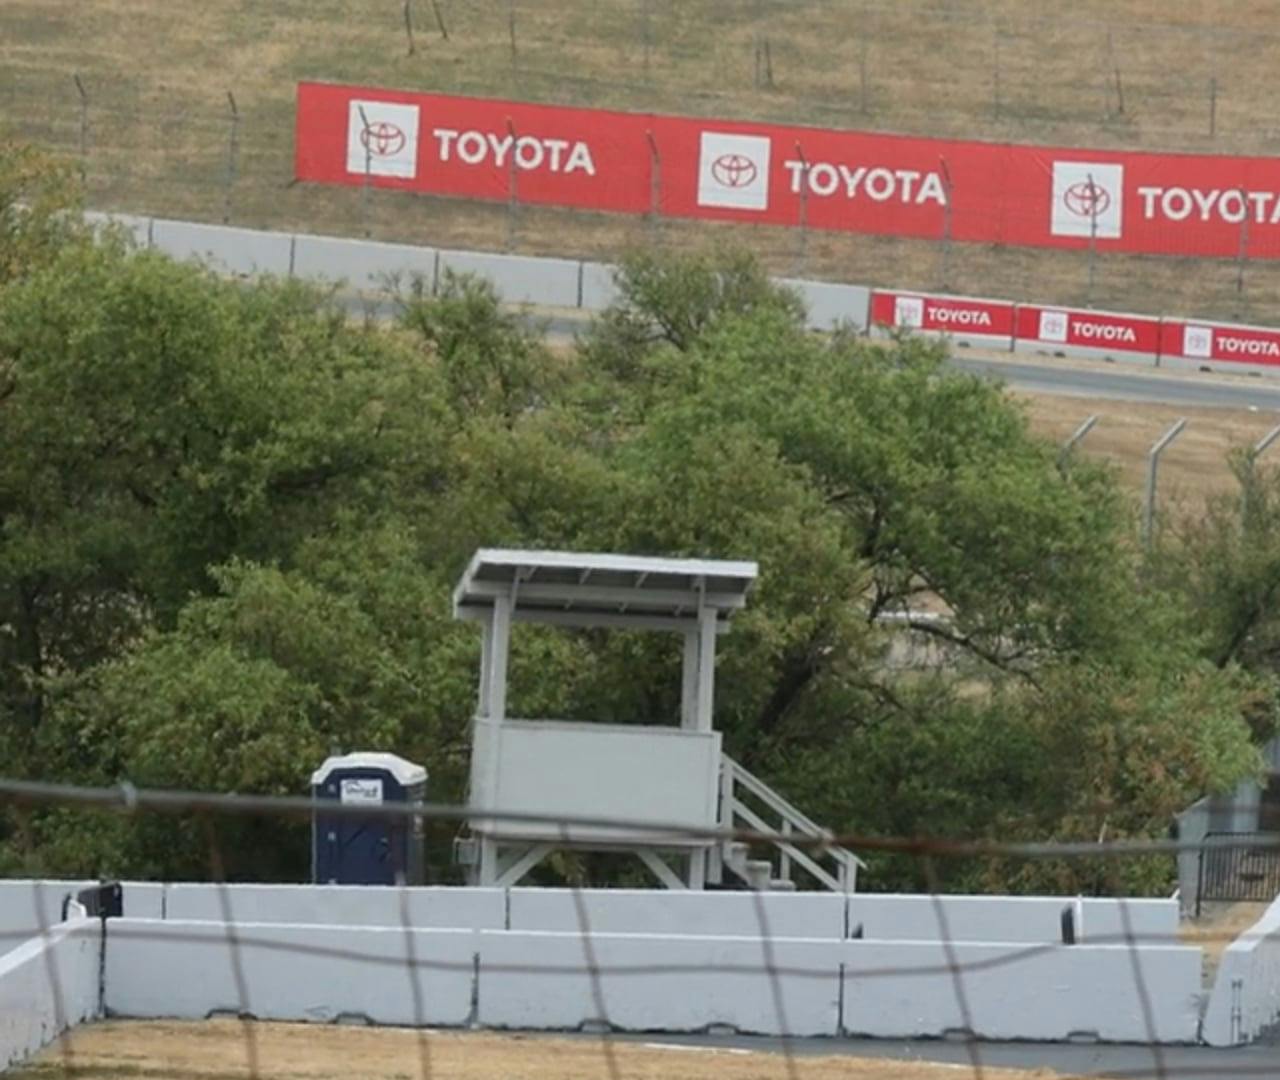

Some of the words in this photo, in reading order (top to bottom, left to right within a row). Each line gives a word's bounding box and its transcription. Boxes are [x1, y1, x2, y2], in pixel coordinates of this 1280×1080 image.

[432, 127, 596, 176] TOYOTA
[783, 159, 947, 206] TOYOTA
[927, 306, 992, 326] TOYOTA
[1072, 320, 1137, 342] TOYOTA
[1217, 336, 1280, 356] TOYOTA
